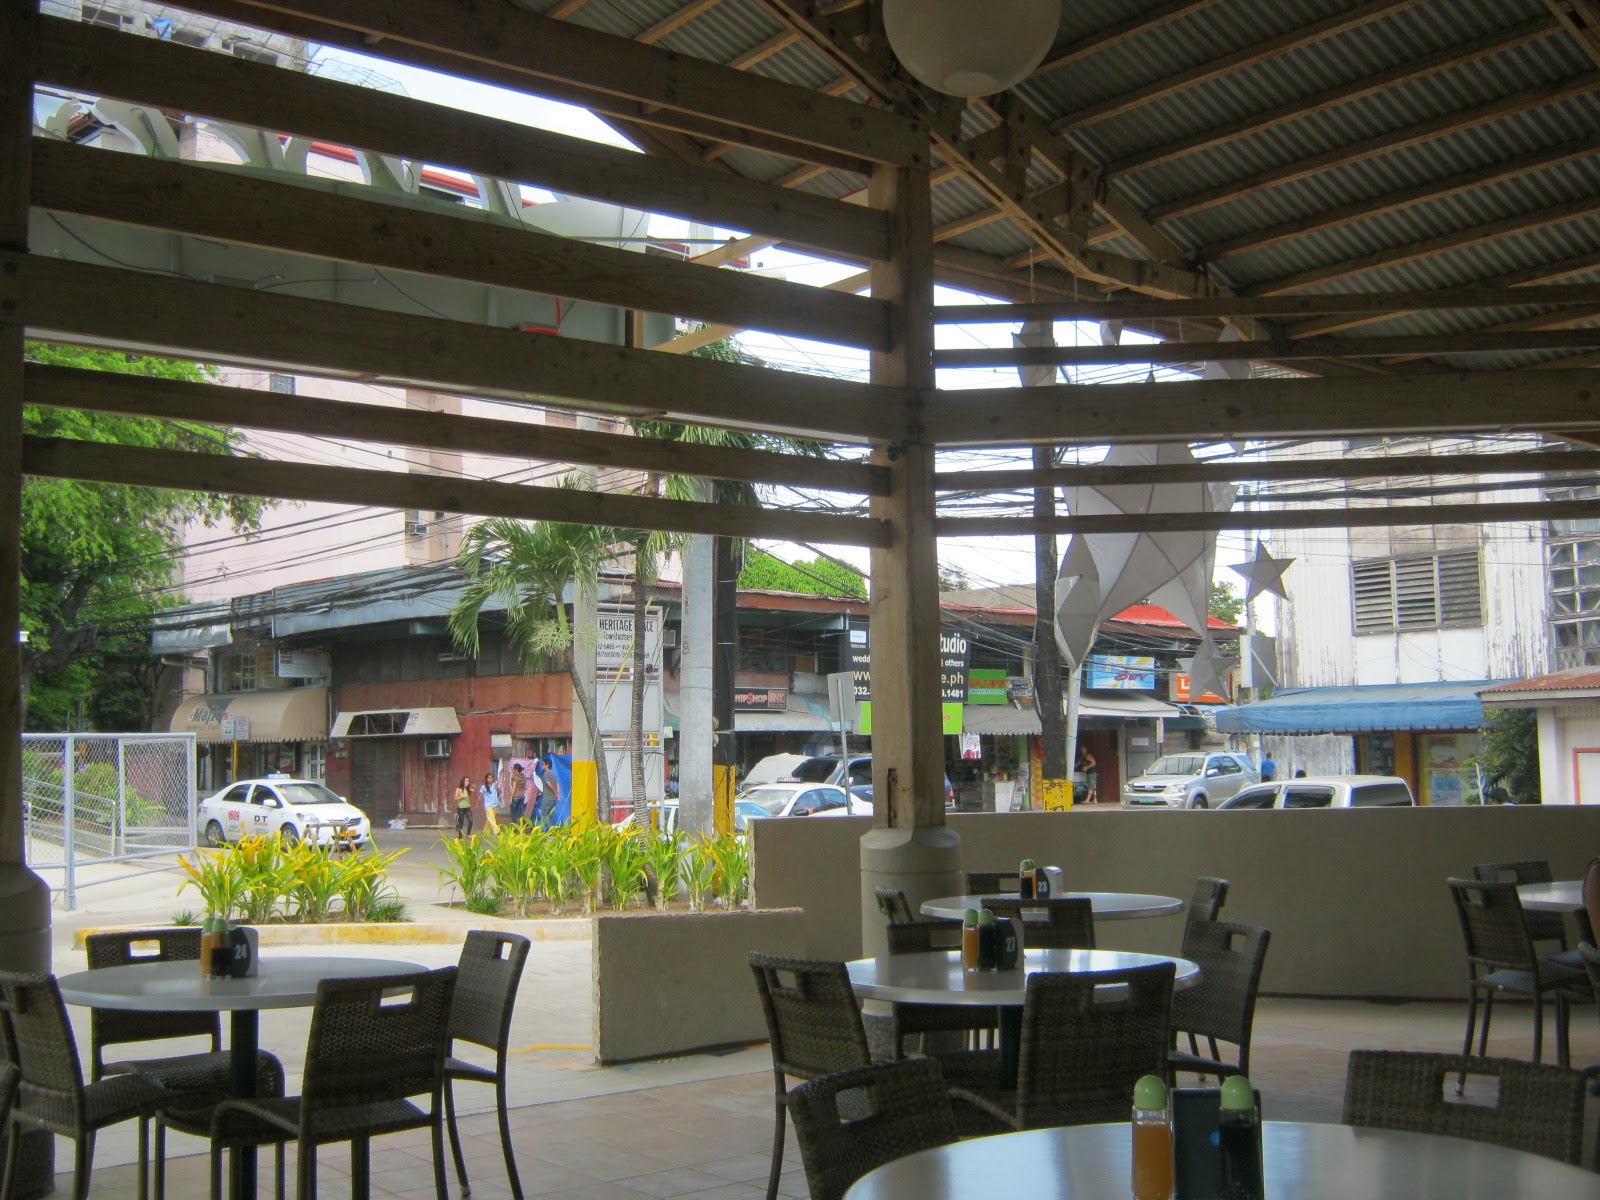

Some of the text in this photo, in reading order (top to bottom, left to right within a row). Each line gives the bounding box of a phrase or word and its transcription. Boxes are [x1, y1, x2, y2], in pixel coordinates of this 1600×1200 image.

[599, 619, 633, 632] HERITAGE
[940, 632, 967, 654] tudio
[852, 655, 964, 667] wedd others
[941, 672, 964, 687] e.ph
[854, 686, 872, 696] 032.
[1038, 881, 1047, 892] 23
[235, 944, 247, 959] 24
[1006, 938, 1015, 952] 27
